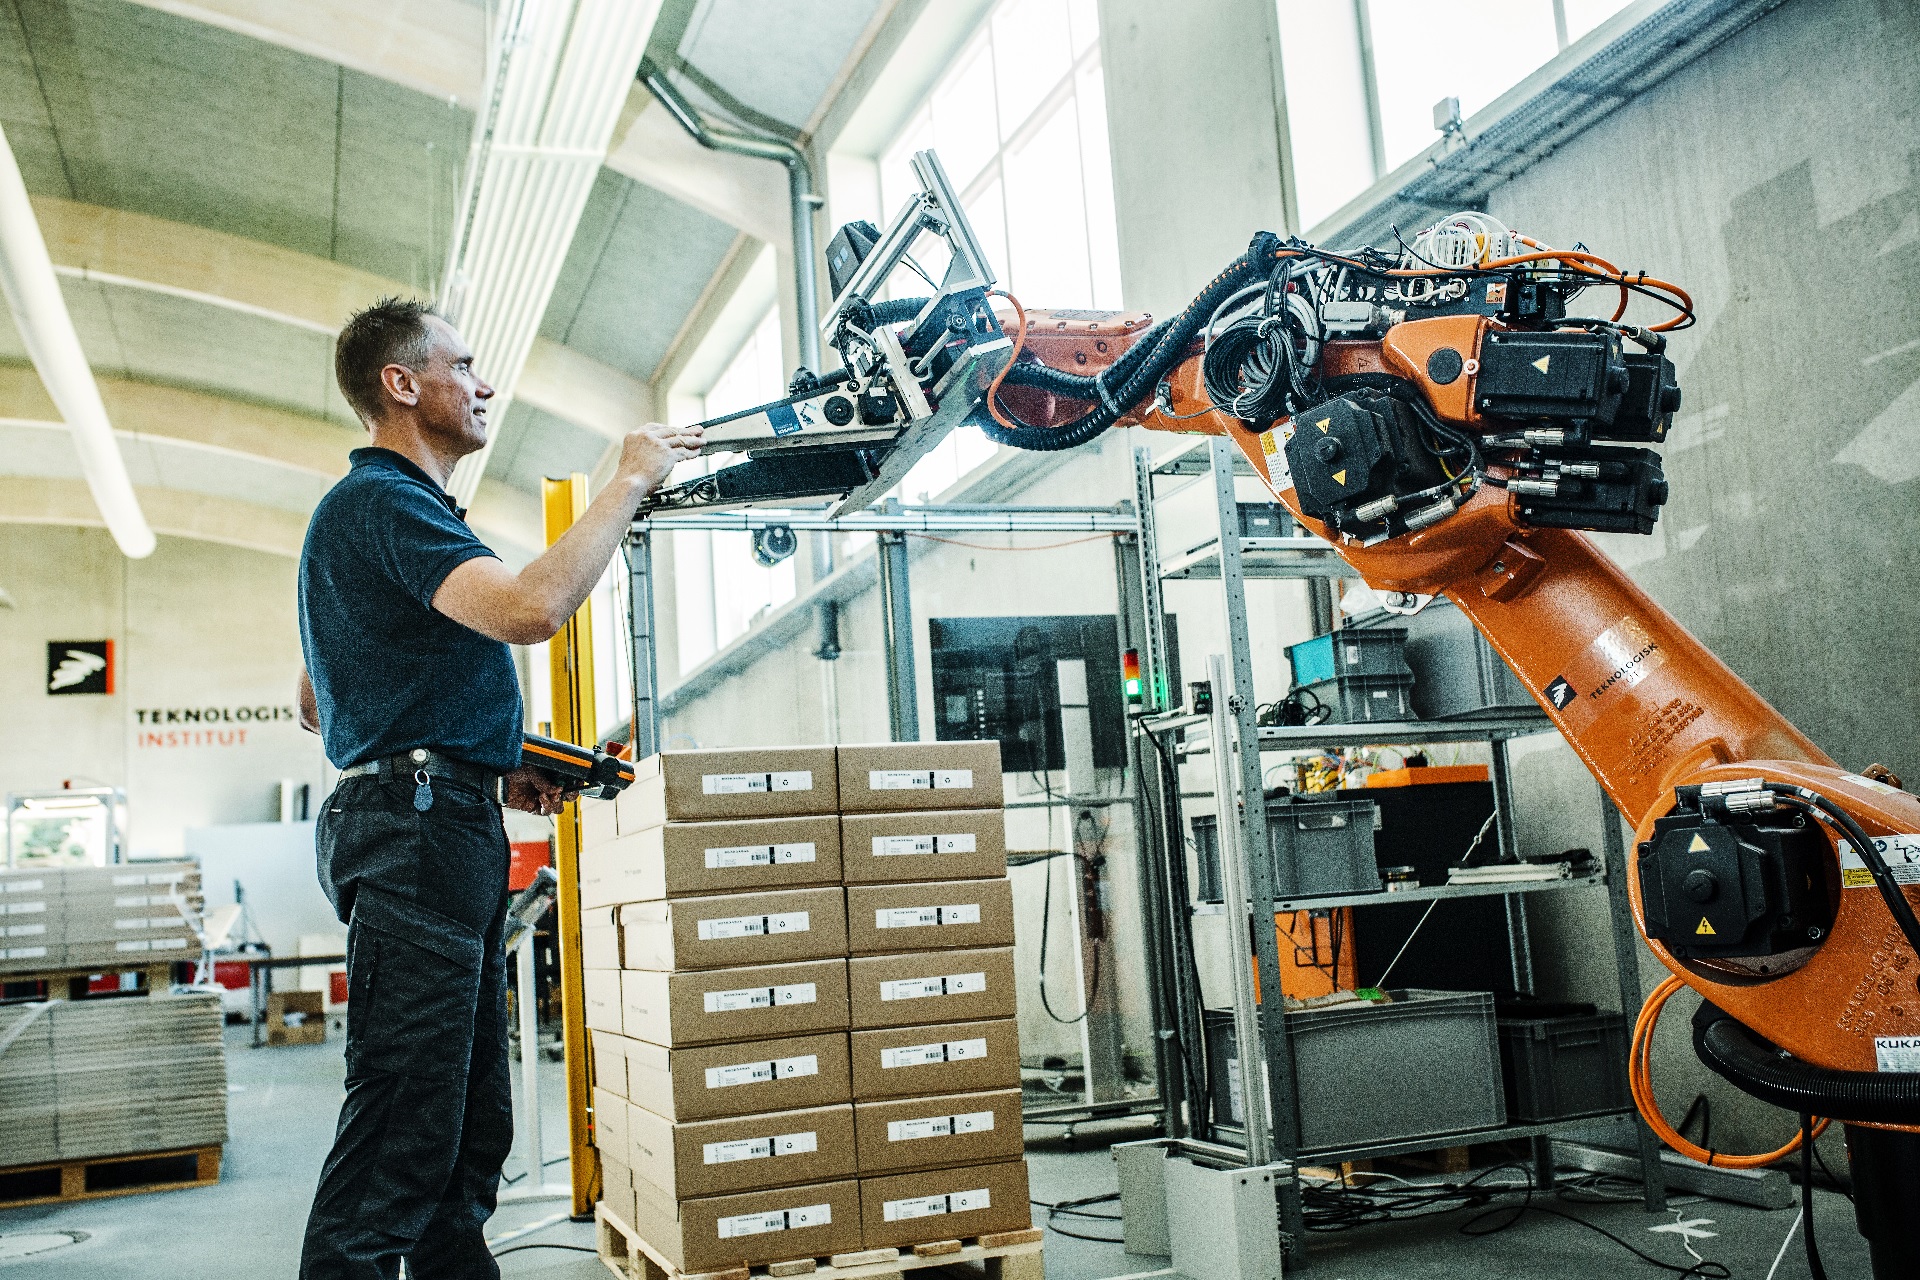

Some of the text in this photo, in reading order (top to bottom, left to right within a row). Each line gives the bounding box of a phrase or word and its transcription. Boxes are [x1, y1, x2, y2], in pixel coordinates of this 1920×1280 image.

[1589, 642, 1659, 700] TEKNOLOGISK
[136, 706, 294, 725] TEKNOLOGIS
[137, 728, 248, 748] INSTITUT
[1876, 1040, 1920, 1049] KUKA
